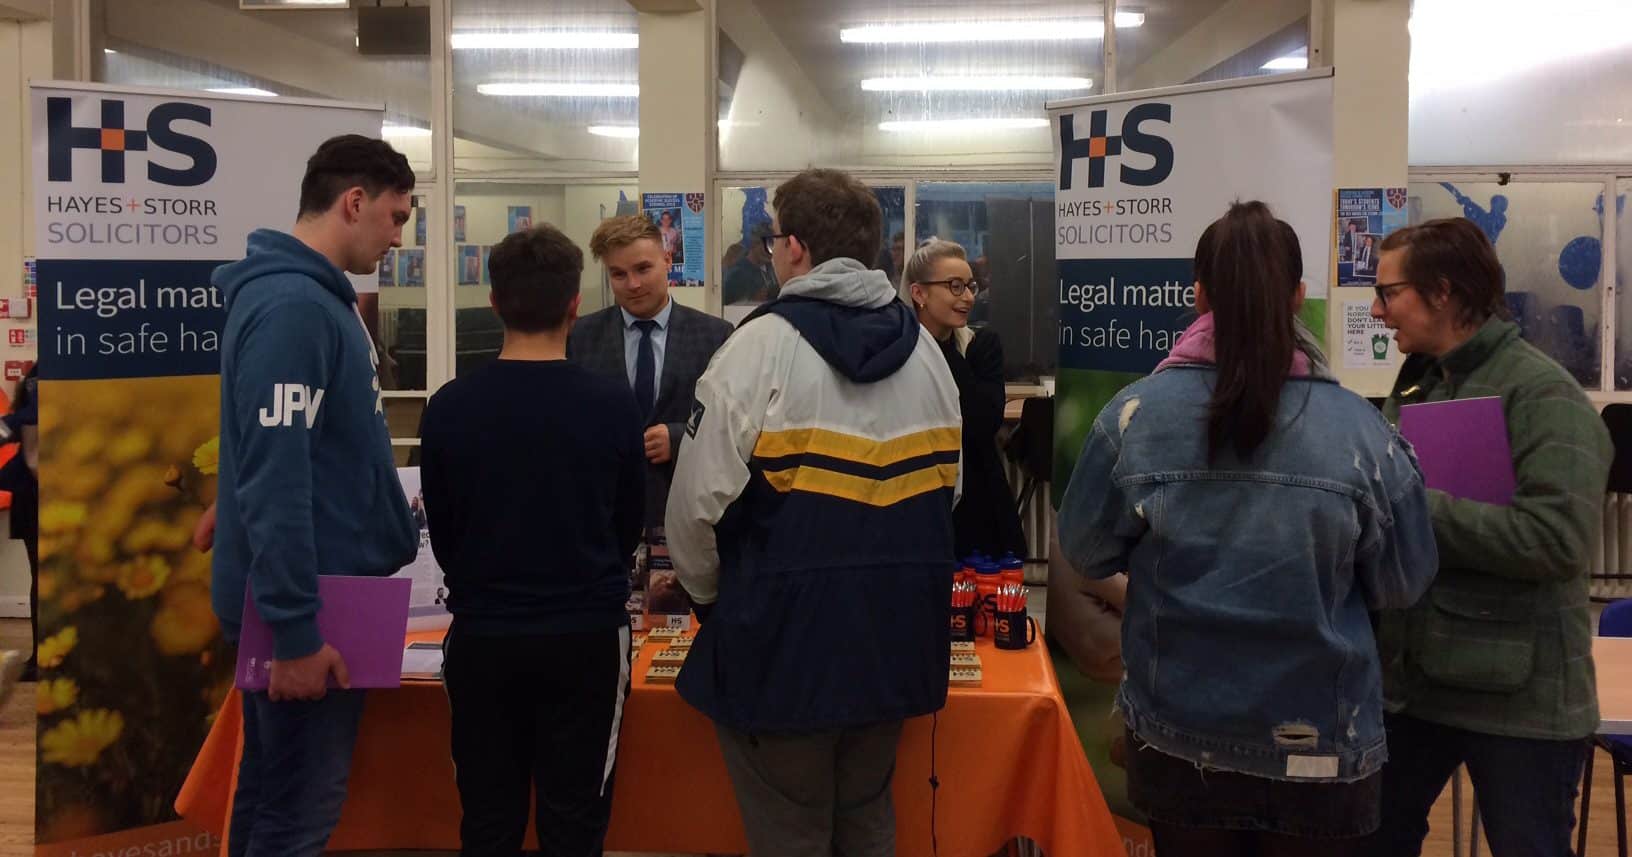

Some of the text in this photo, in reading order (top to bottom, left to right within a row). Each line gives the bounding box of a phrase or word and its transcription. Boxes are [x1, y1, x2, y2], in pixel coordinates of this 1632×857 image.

[47, 221, 219, 246] SOLICITORS
[1057, 222, 1173, 246] SOLICITORS
[56, 279, 225, 318] Legal mat
[1059, 276, 1196, 313] Legal matte
[56, 326, 86, 355] in
[98, 321, 168, 355] safe
[180, 322, 218, 352] ha
[1058, 319, 1185, 352] in safe han
